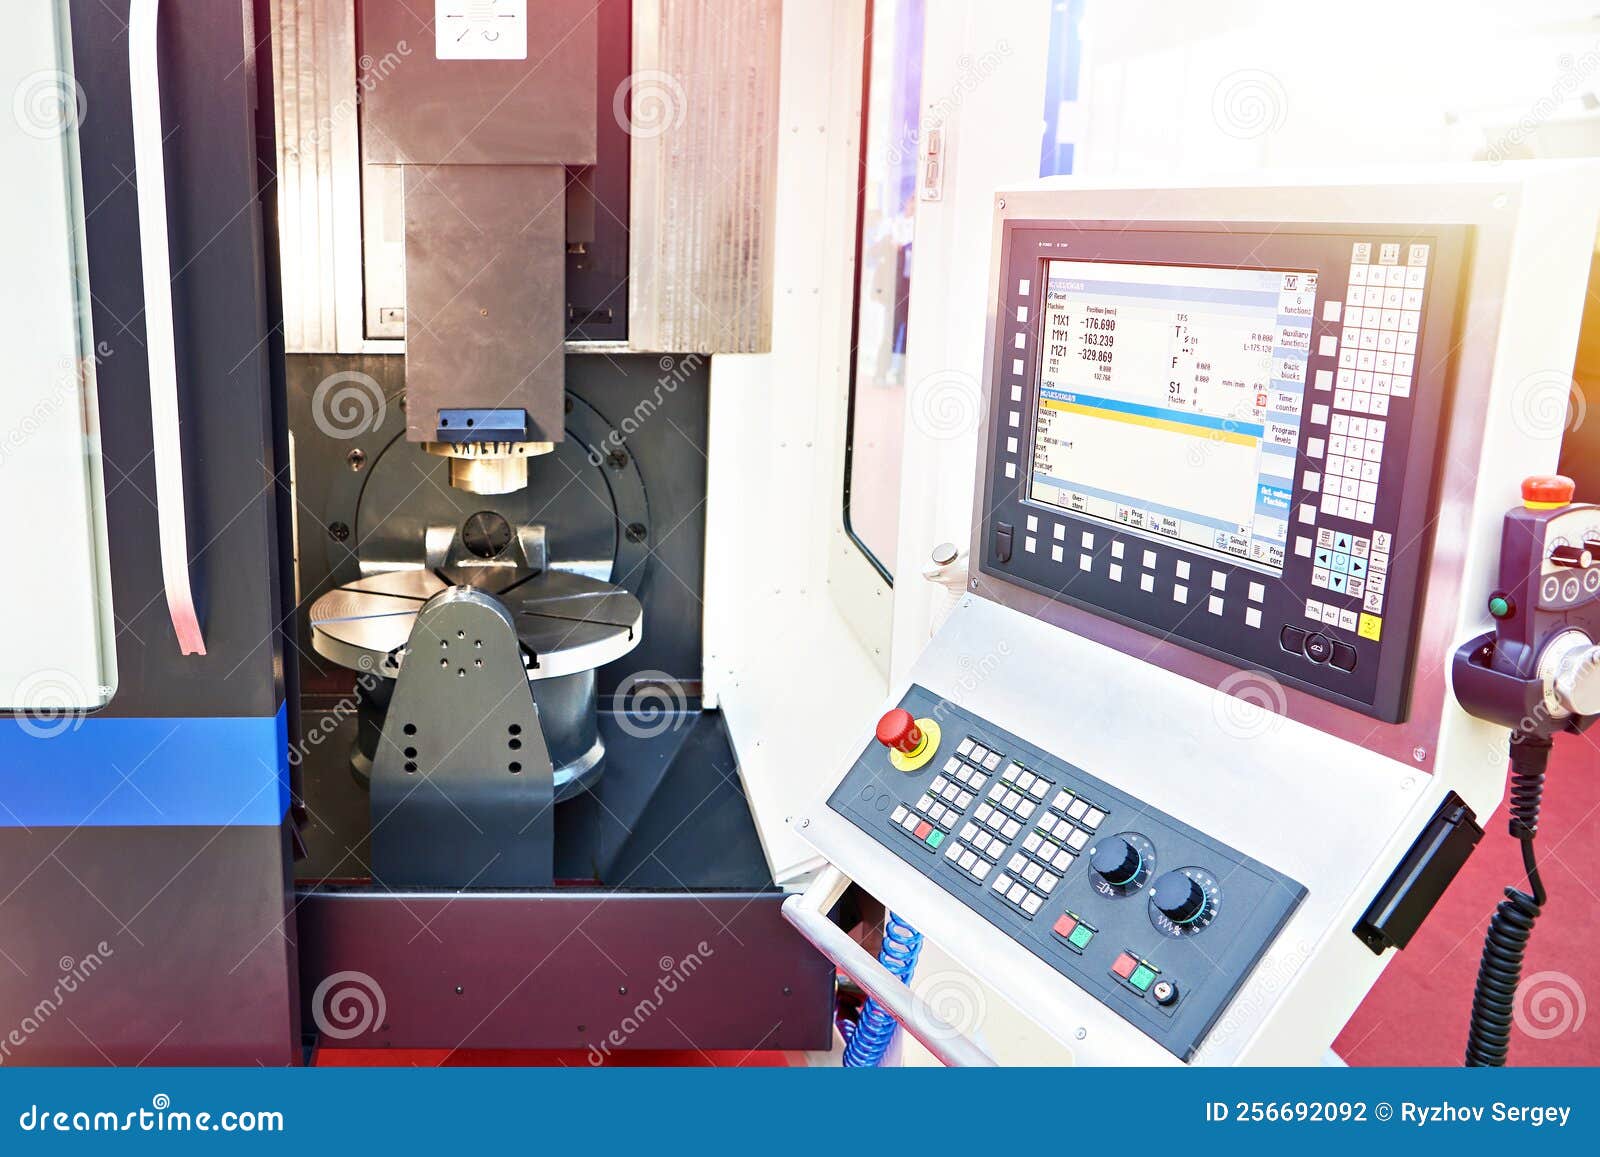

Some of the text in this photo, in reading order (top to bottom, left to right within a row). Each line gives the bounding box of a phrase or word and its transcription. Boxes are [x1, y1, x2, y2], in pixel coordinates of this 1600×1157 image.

[1053, 314, 1116, 331] MX1 -176.690
[1175, 325, 1182, 338] T
[1052, 330, 1114, 348] MY1 -163.239
[1051, 344, 1112, 363] MZ1 -329.869
[1172, 356, 1178, 369] F
[1169, 381, 1180, 394] S1
[1271, 424, 1298, 436] Program
[1342, 616, 1352, 624] DEL
